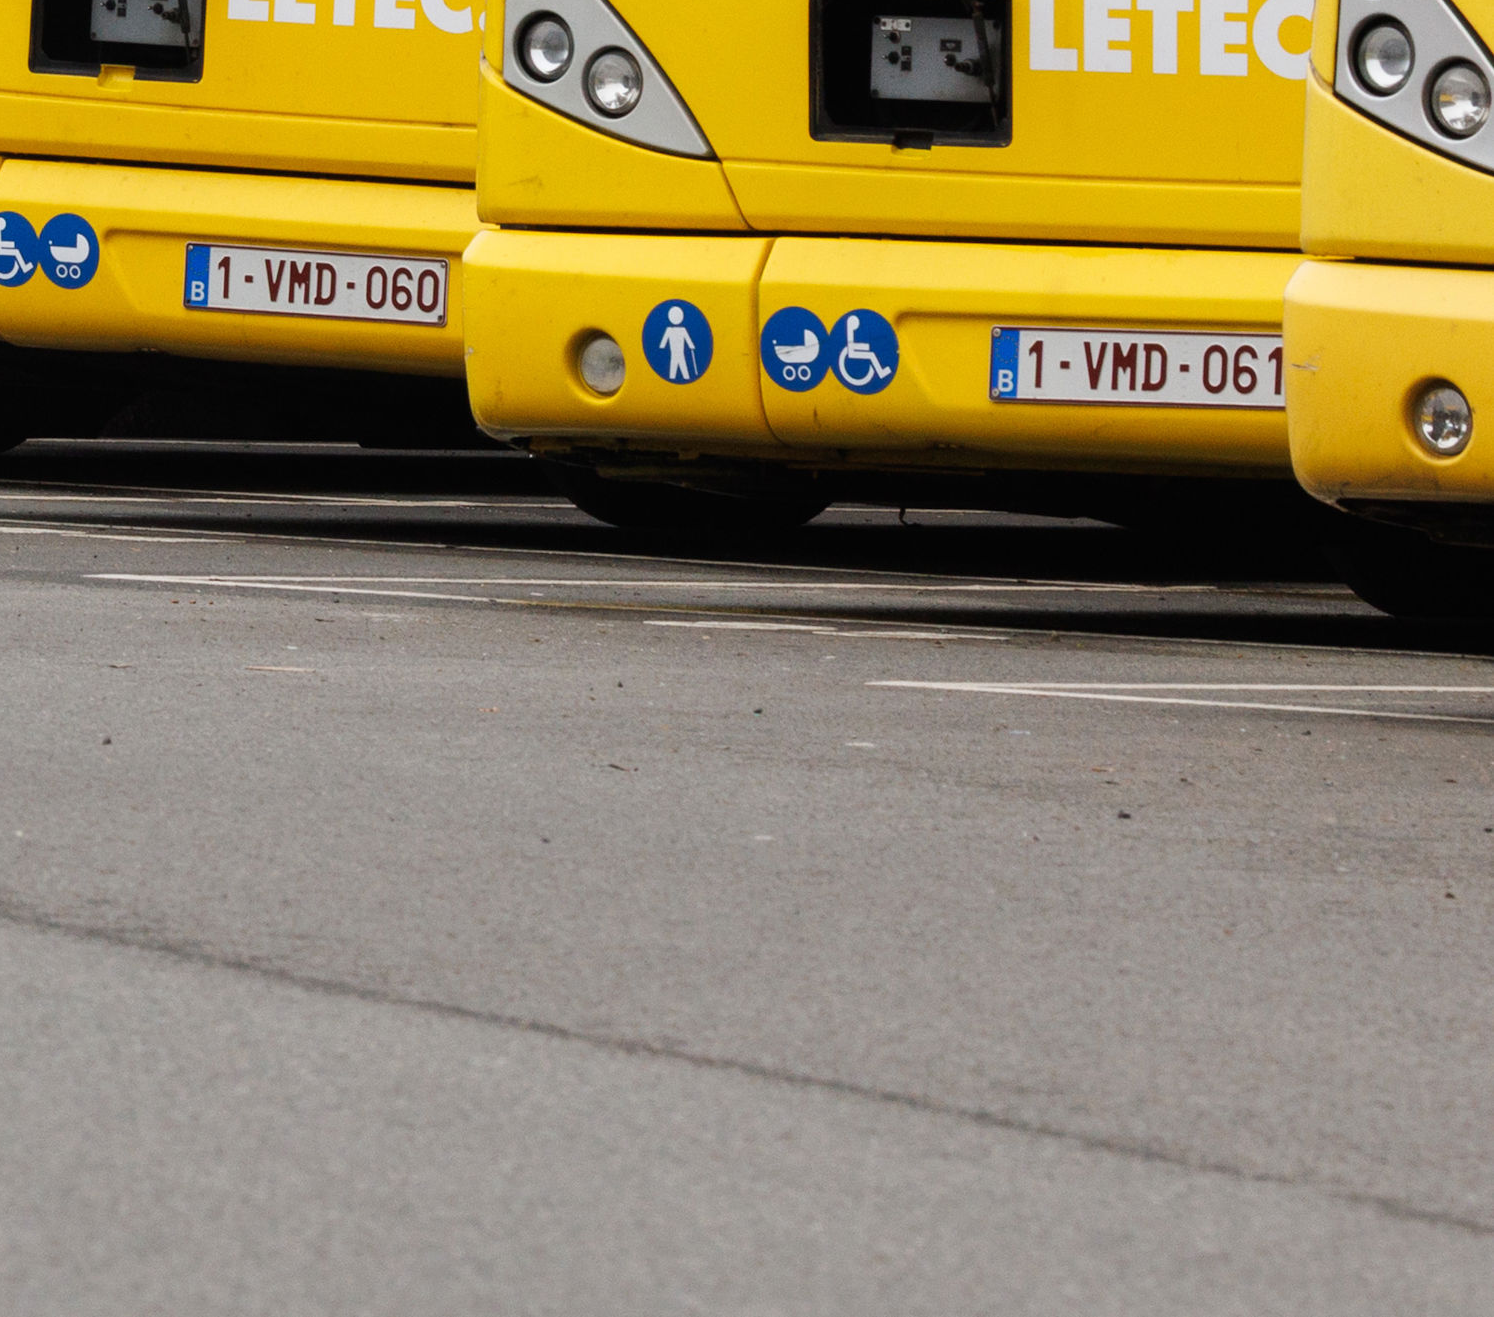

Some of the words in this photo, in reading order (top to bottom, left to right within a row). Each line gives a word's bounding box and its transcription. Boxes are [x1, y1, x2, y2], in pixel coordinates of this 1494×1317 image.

[190, 281, 206, 302] B
[218, 256, 440, 313] 1-VMD-060
[997, 369, 1014, 392] B
[1028, 340, 1283, 396] 1-VMD-061
